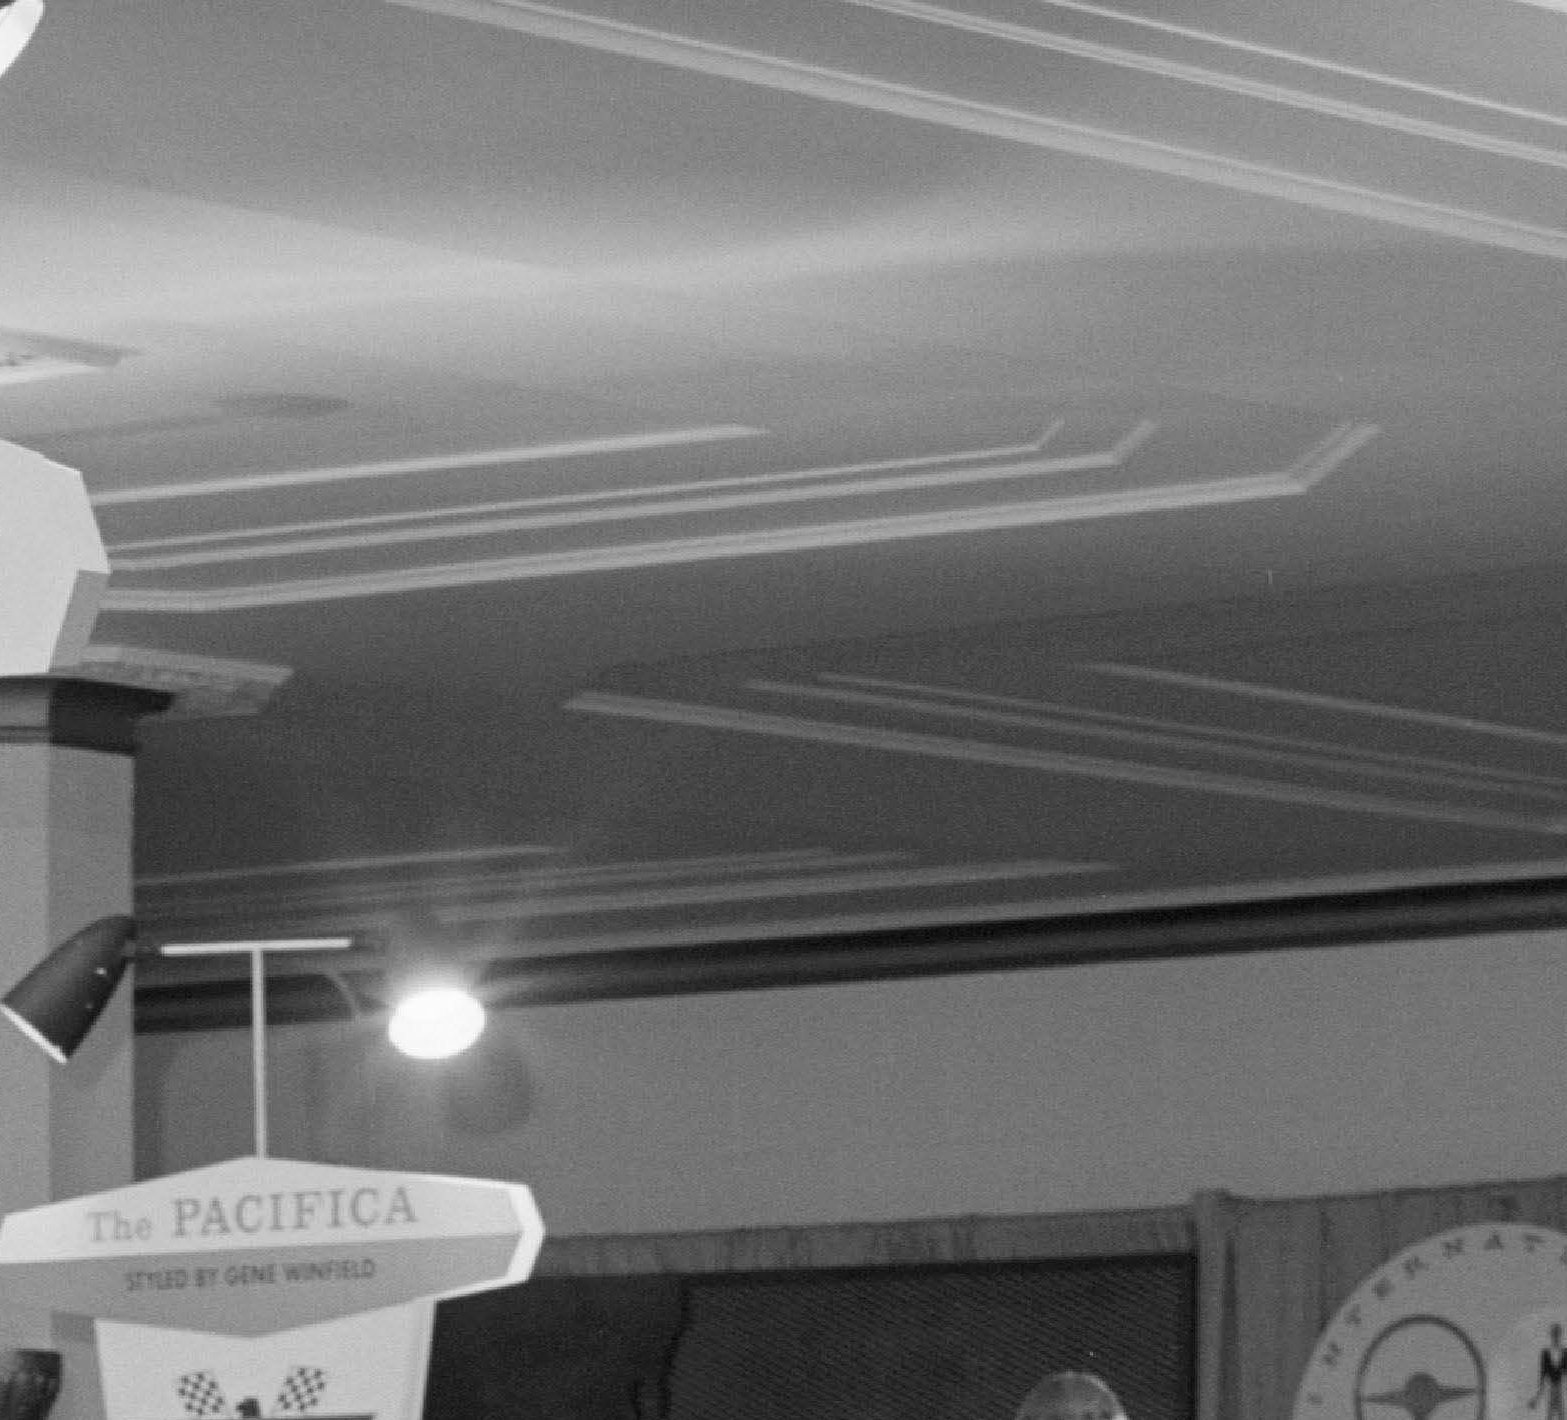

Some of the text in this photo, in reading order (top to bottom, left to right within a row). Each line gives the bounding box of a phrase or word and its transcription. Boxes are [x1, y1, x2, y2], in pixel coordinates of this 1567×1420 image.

[87, 1186, 419, 1242] The PACIFICA
[123, 1256, 378, 1293] STYLED BY GENE WINFIELD
